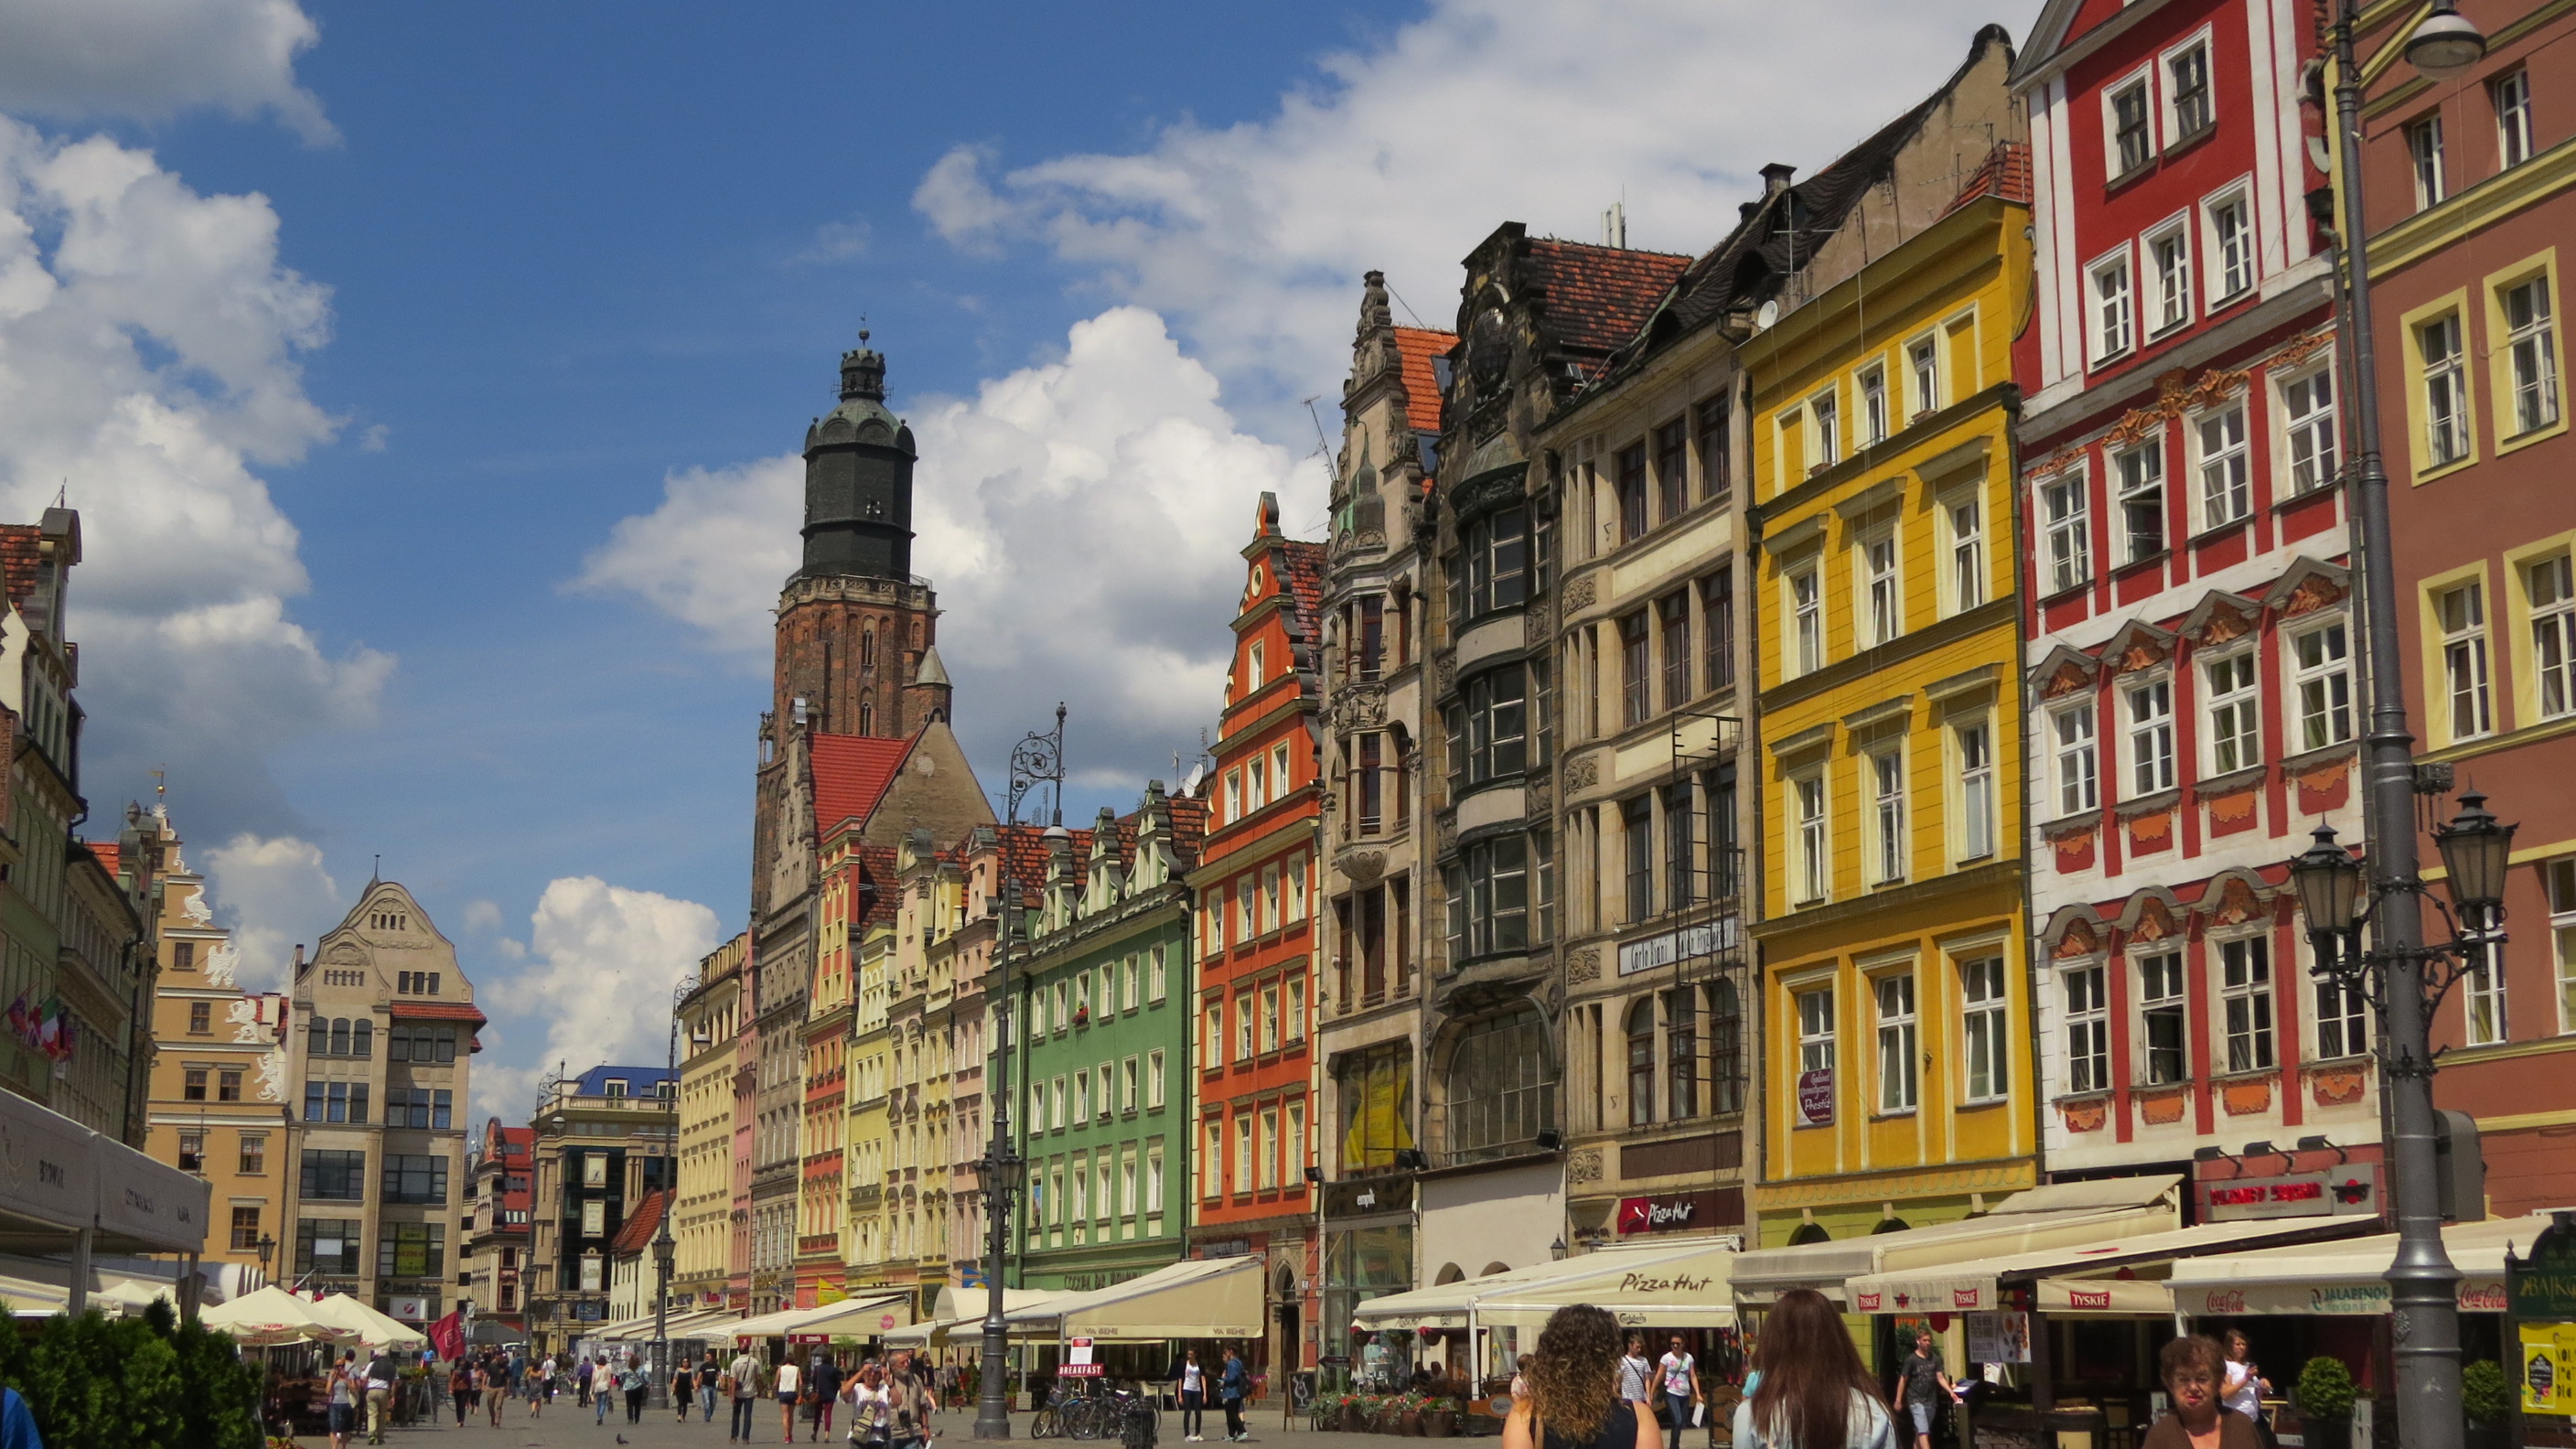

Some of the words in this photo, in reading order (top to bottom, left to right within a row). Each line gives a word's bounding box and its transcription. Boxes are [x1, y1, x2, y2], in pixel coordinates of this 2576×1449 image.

[1647, 1203, 1672, 1226] Pizza
[1672, 1200, 1693, 1222] Hut
[1620, 1272, 1670, 1293] Pizza
[1673, 1273, 1713, 1292] Hut
[1859, 1294, 1879, 1309] TYSKIE
[1955, 1291, 1976, 1305] TYSKIE
[2072, 1293, 2108, 1306] TYSKIE
[2206, 1290, 2246, 1314] Coca-Cola
[1059, 1365, 1102, 1375] BREAKFAST
